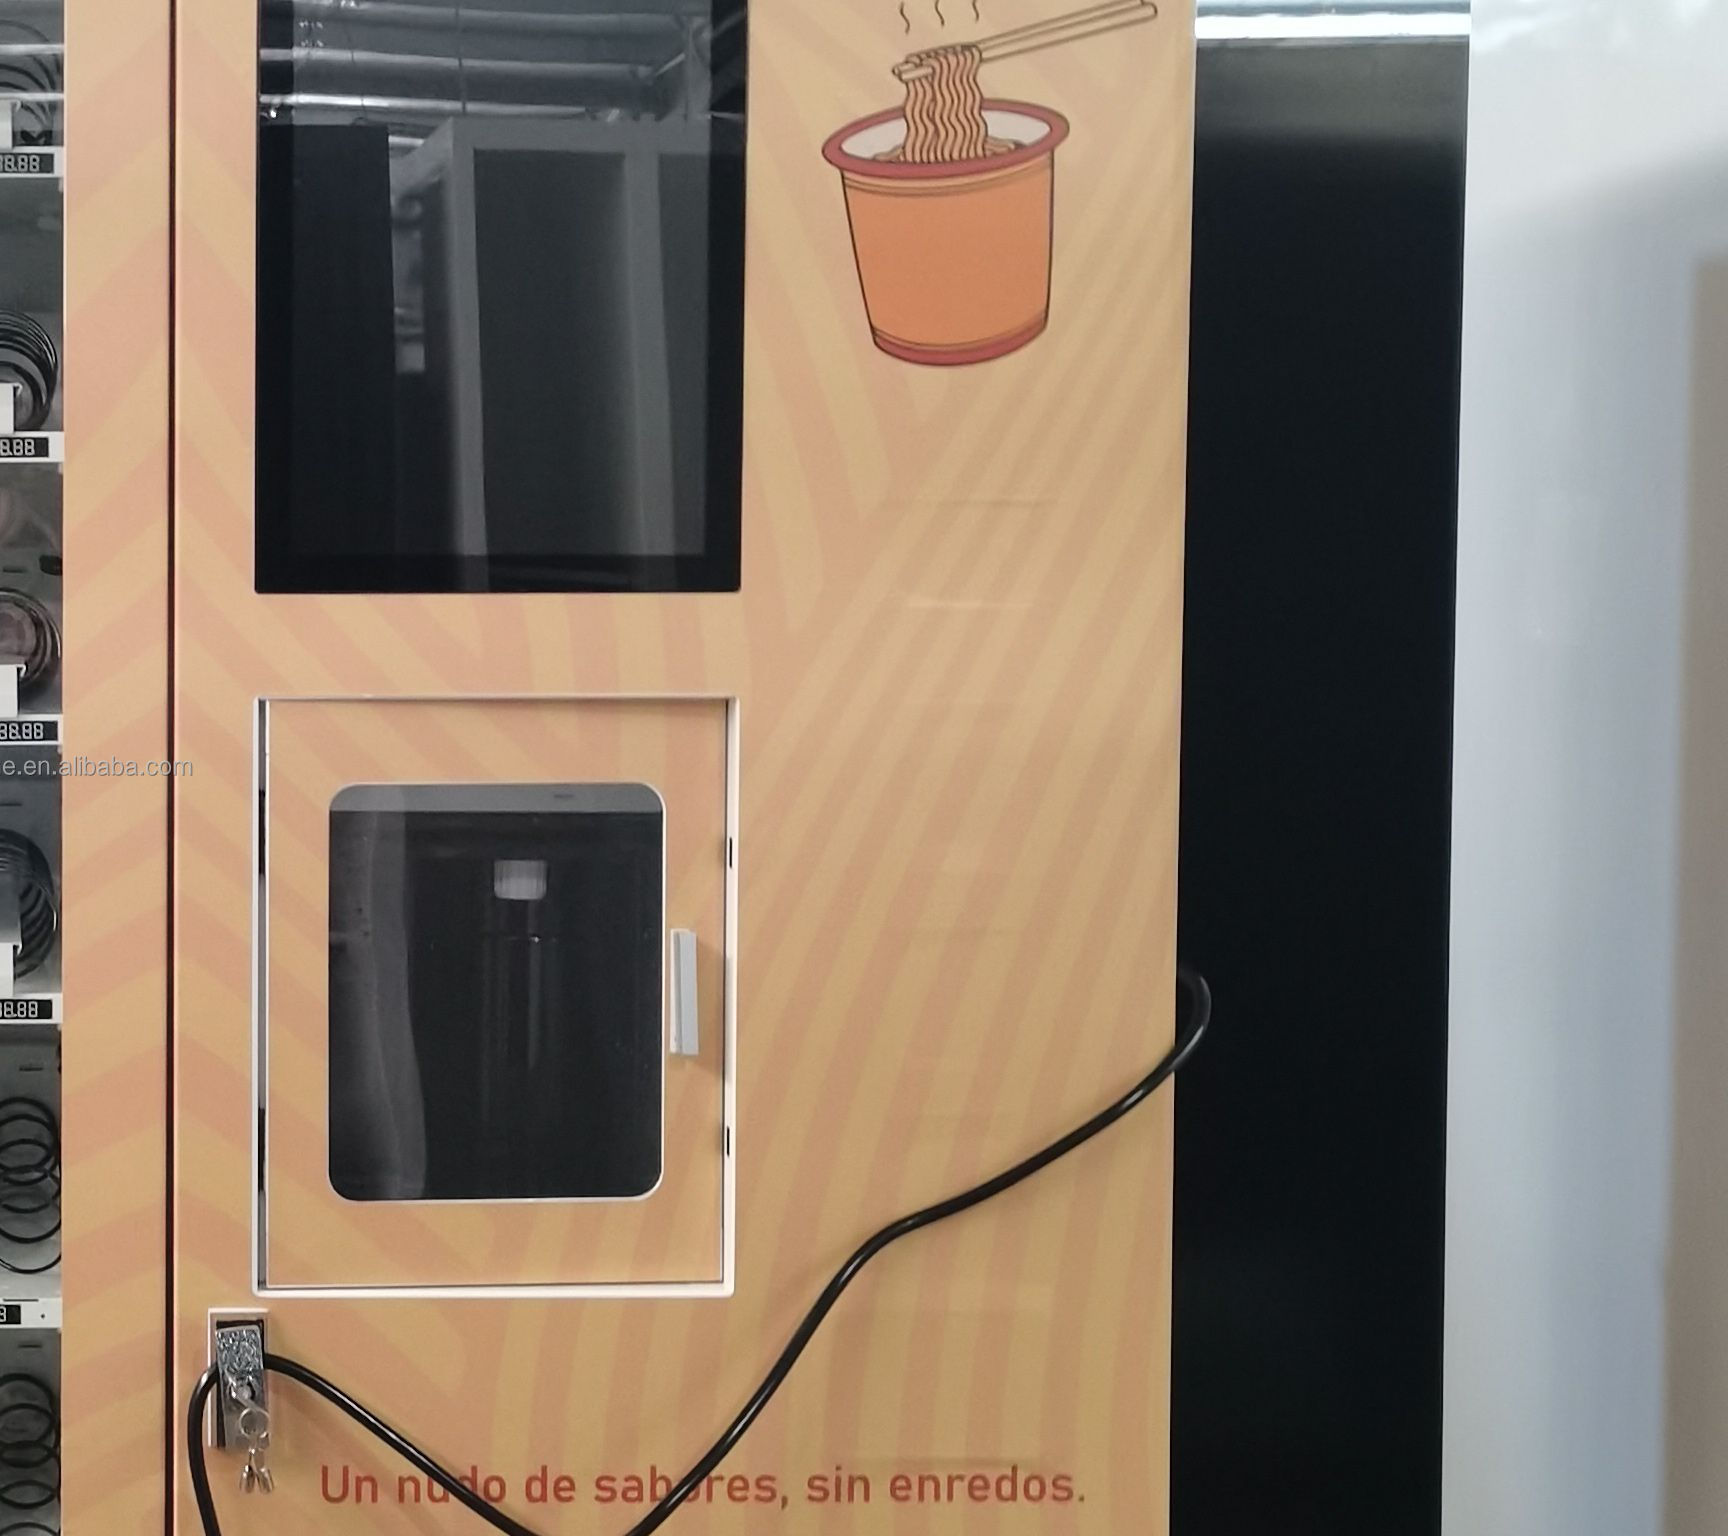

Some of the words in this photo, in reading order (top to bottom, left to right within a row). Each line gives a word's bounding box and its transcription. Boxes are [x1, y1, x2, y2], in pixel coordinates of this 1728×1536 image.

[321, 1465, 378, 1503] Un
[525, 1465, 576, 1503] de
[807, 1465, 871, 1505] sin
[889, 1465, 1085, 1505] enredos.
